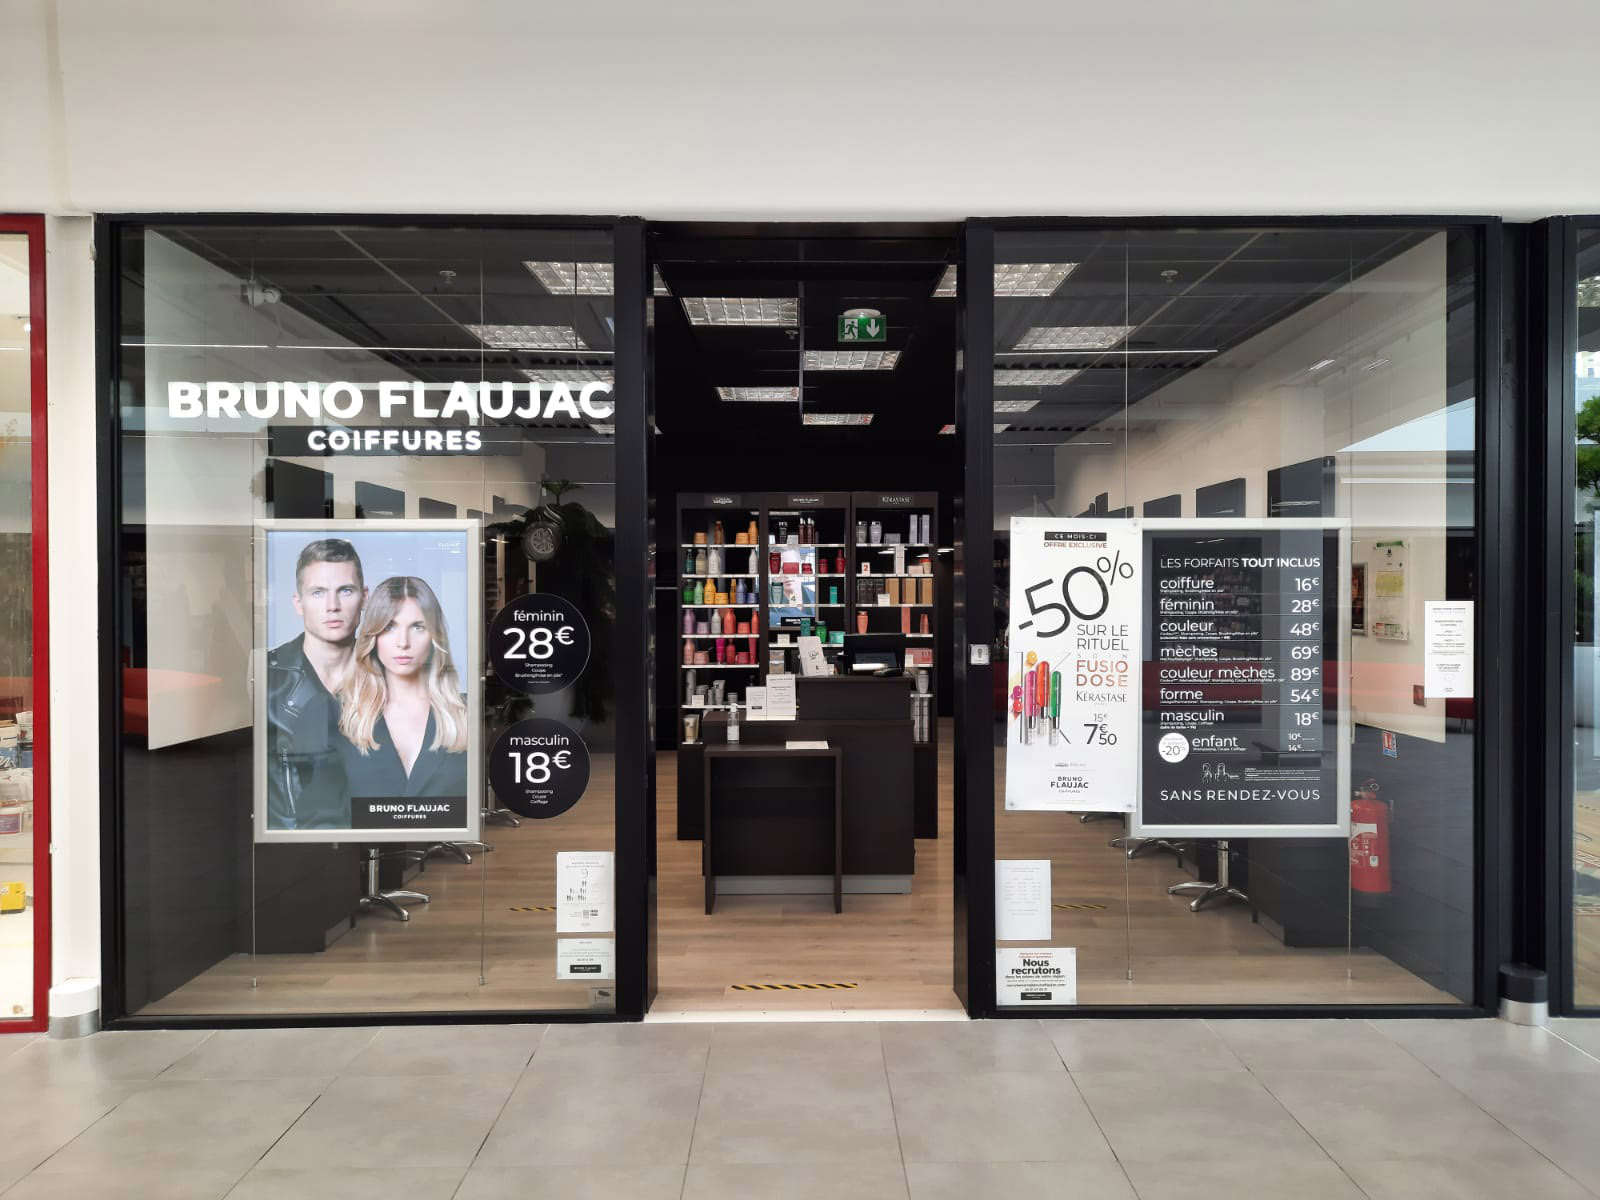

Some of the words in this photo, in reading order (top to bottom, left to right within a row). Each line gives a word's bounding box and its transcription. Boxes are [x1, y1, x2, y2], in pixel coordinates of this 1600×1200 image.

[167, 381, 364, 419] BRUNO
[379, 381, 614, 419] FLAUJAC
[308, 430, 482, 451] COIFFURES
[1160, 558, 1181, 568] LES
[1184, 558, 1239, 568] FORFAITS
[1241, 557, 1274, 568] TOUT
[1277, 557, 1320, 568] INCLUS
[1160, 576, 1214, 589] coiffure
[1294, 577, 1320, 592] 16€
[1018, 549, 1134, 639] -50%
[1160, 597, 1214, 610] féminin
[1291, 598, 1320, 613] 28€
[513, 609, 564, 622] féminin
[1076, 624, 1107, 636] SUR
[1111, 624, 1129, 637] LE
[1160, 619, 1214, 632] couleur
[1290, 622, 1320, 636] 48€
[503, 625, 575, 660] 28€
[1076, 638, 1129, 651] RITUEL
[1160, 645, 1218, 657] mèches
[1291, 646, 1320, 660] 69€
[1076, 660, 1128, 673] FUSIO
[1160, 666, 1214, 679] couleur
[1218, 666, 1275, 679] mèches
[1290, 667, 1320, 681] 89€
[1076, 674, 1128, 687] DOSE
[1160, 687, 1204, 700] forme
[1290, 688, 1320, 703] 54€
[1160, 709, 1225, 721] masculin
[1294, 712, 1320, 726] 18€
[510, 734, 569, 746] masculin
[1192, 735, 1238, 747] enfant
[508, 750, 571, 784] 18€
[1050, 781, 1089, 789] FLAUJAC
[1160, 790, 1202, 801] SANS
[1207, 789, 1320, 801] RENDEZ-VOUS
[369, 804, 405, 813] BRUNO
[407, 804, 450, 812] FLAUJAC
[1022, 958, 1050, 967] Nous
[1011, 967, 1061, 975] recrutons
